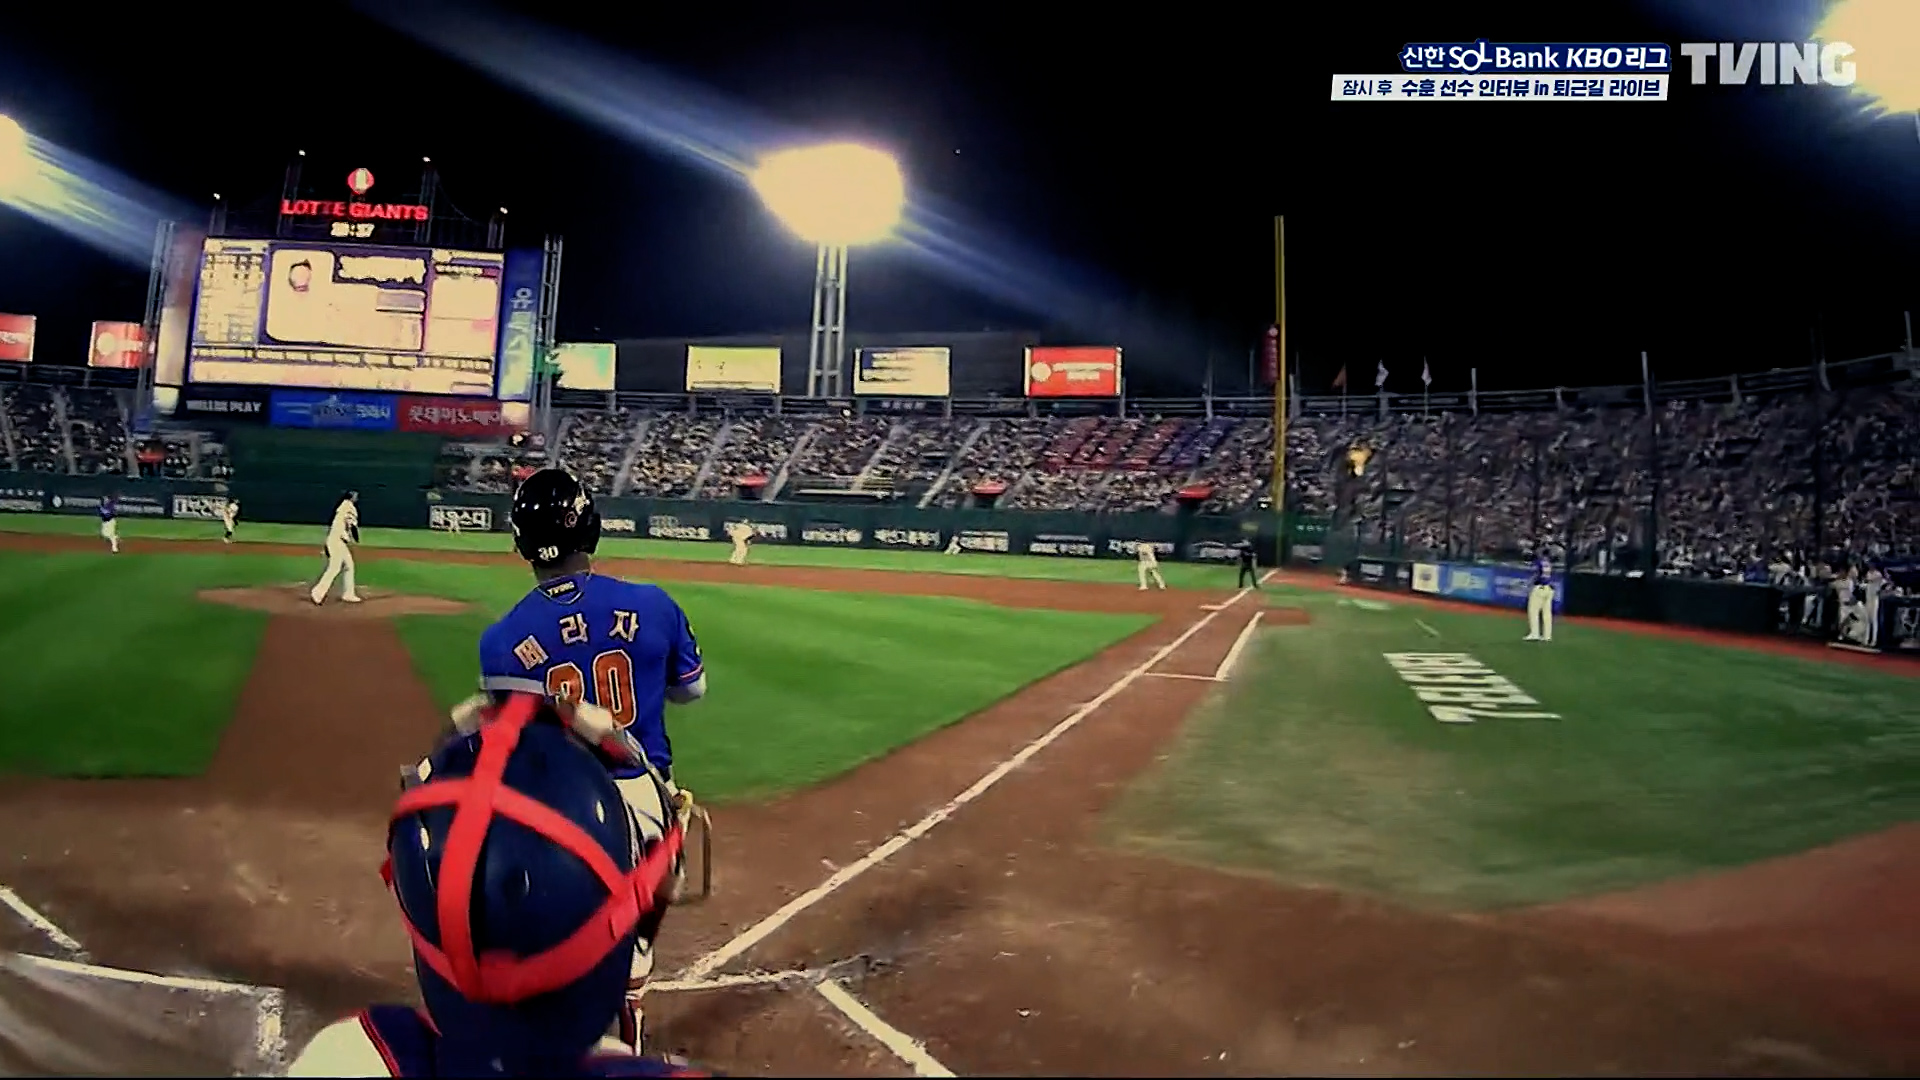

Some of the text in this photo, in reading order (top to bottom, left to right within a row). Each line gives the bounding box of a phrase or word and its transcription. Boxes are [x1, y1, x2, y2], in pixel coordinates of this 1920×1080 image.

[281, 200, 429, 220] LOTTE GIANTS
[538, 545, 560, 562] 30
